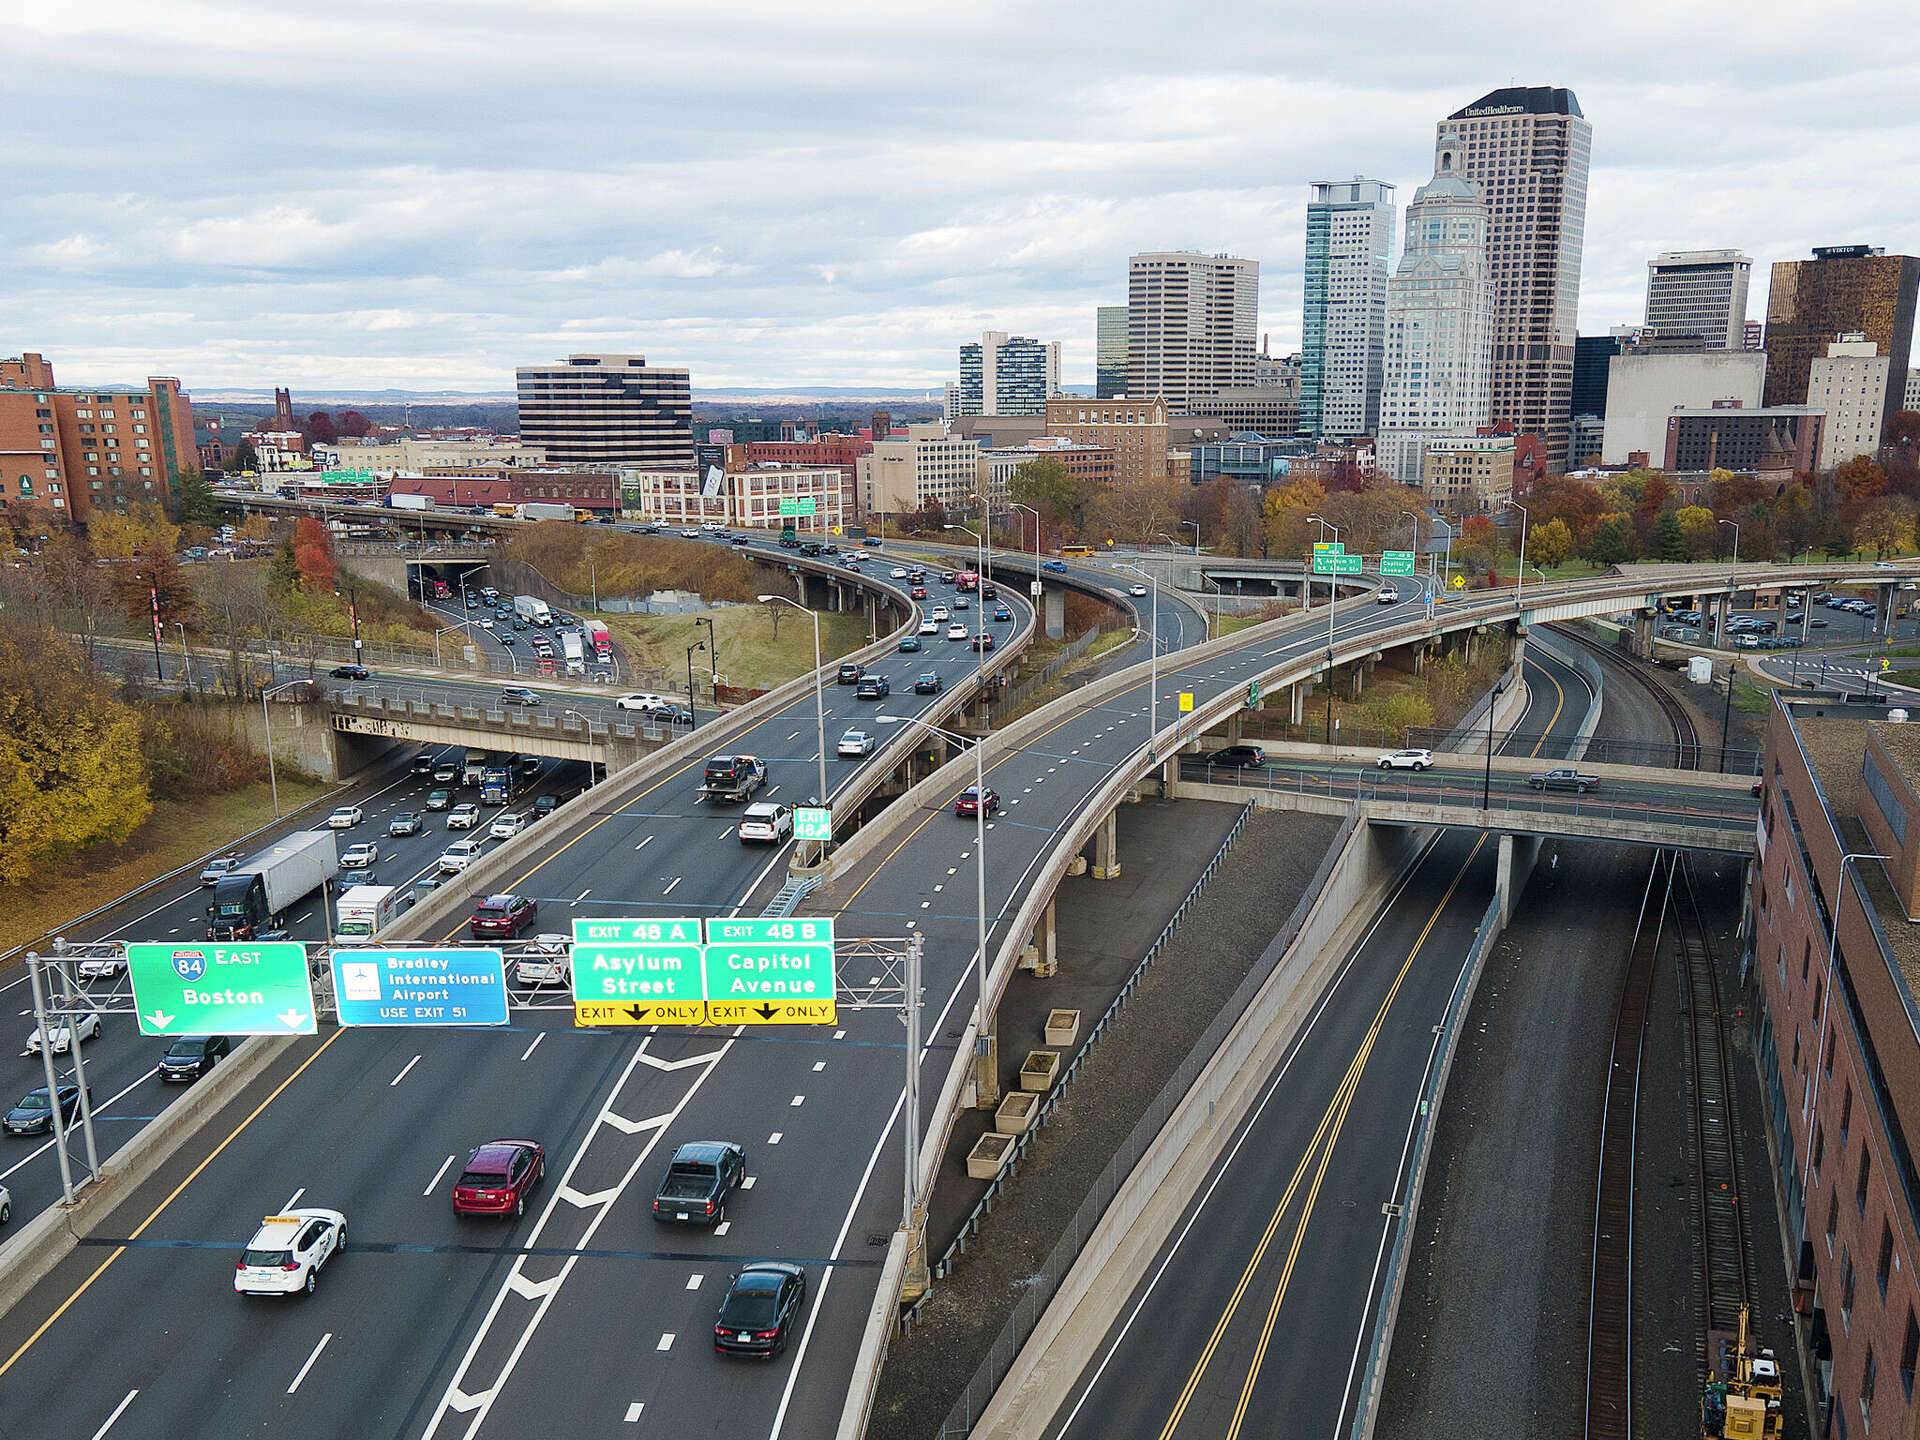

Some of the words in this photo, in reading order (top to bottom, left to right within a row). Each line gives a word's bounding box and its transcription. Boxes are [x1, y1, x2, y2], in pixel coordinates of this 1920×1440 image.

[1465, 105, 1524, 117] UnitedHealthcare
[799, 811, 825, 823] EXIT
[796, 824, 814, 837] 48
[589, 926, 622, 938] EXIT
[632, 924, 662, 940] 48
[669, 924, 686, 940] A
[723, 925, 755, 937] EXIT
[766, 923, 795, 939] 48
[802, 923, 817, 939] B
[178, 959, 203, 975] 84
[215, 949, 262, 965] EAST
[386, 957, 449, 971] Bradley
[592, 953, 682, 974] Asylum
[728, 953, 811, 973] Capitol
[388, 973, 496, 986] International
[602, 977, 676, 995] Street
[730, 977, 817, 994] Avenue
[183, 988, 264, 1006] Boston
[392, 988, 450, 1002] Airport
[379, 1007, 409, 1018] USE
[414, 1007, 445, 1018] EXIT
[452, 1007, 467, 1018] 51
[581, 1007, 616, 1018] EXIT
[655, 1007, 698, 1018] ONLY
[713, 1007, 747, 1018] EXIT
[785, 1006, 828, 1017] ONLY
